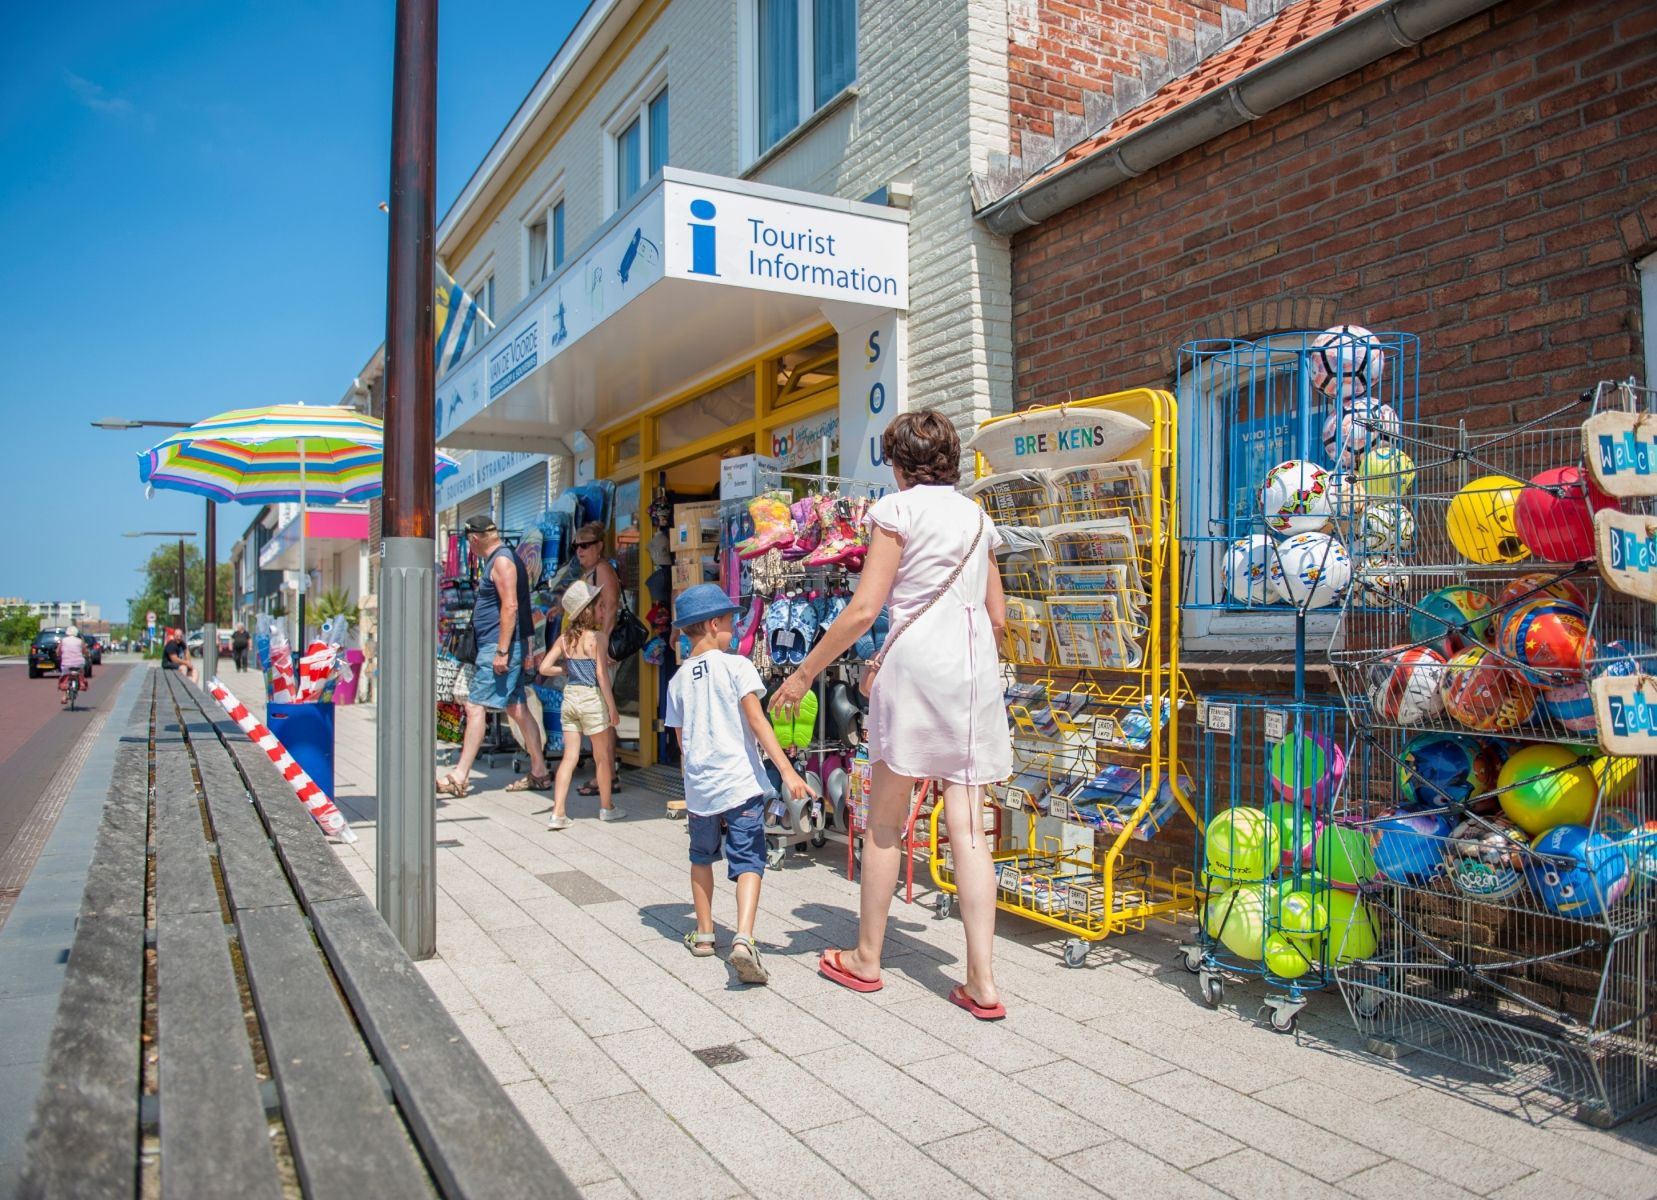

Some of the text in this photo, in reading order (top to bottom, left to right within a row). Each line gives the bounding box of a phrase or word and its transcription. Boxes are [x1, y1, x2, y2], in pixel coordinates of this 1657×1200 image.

[748, 218, 835, 256] Tourist
[750, 250, 897, 295] Information
[511, 329, 537, 366] VOORDE
[1014, 425, 1104, 456] BRESKENS
[446, 473, 475, 500] SOUVENIRS
